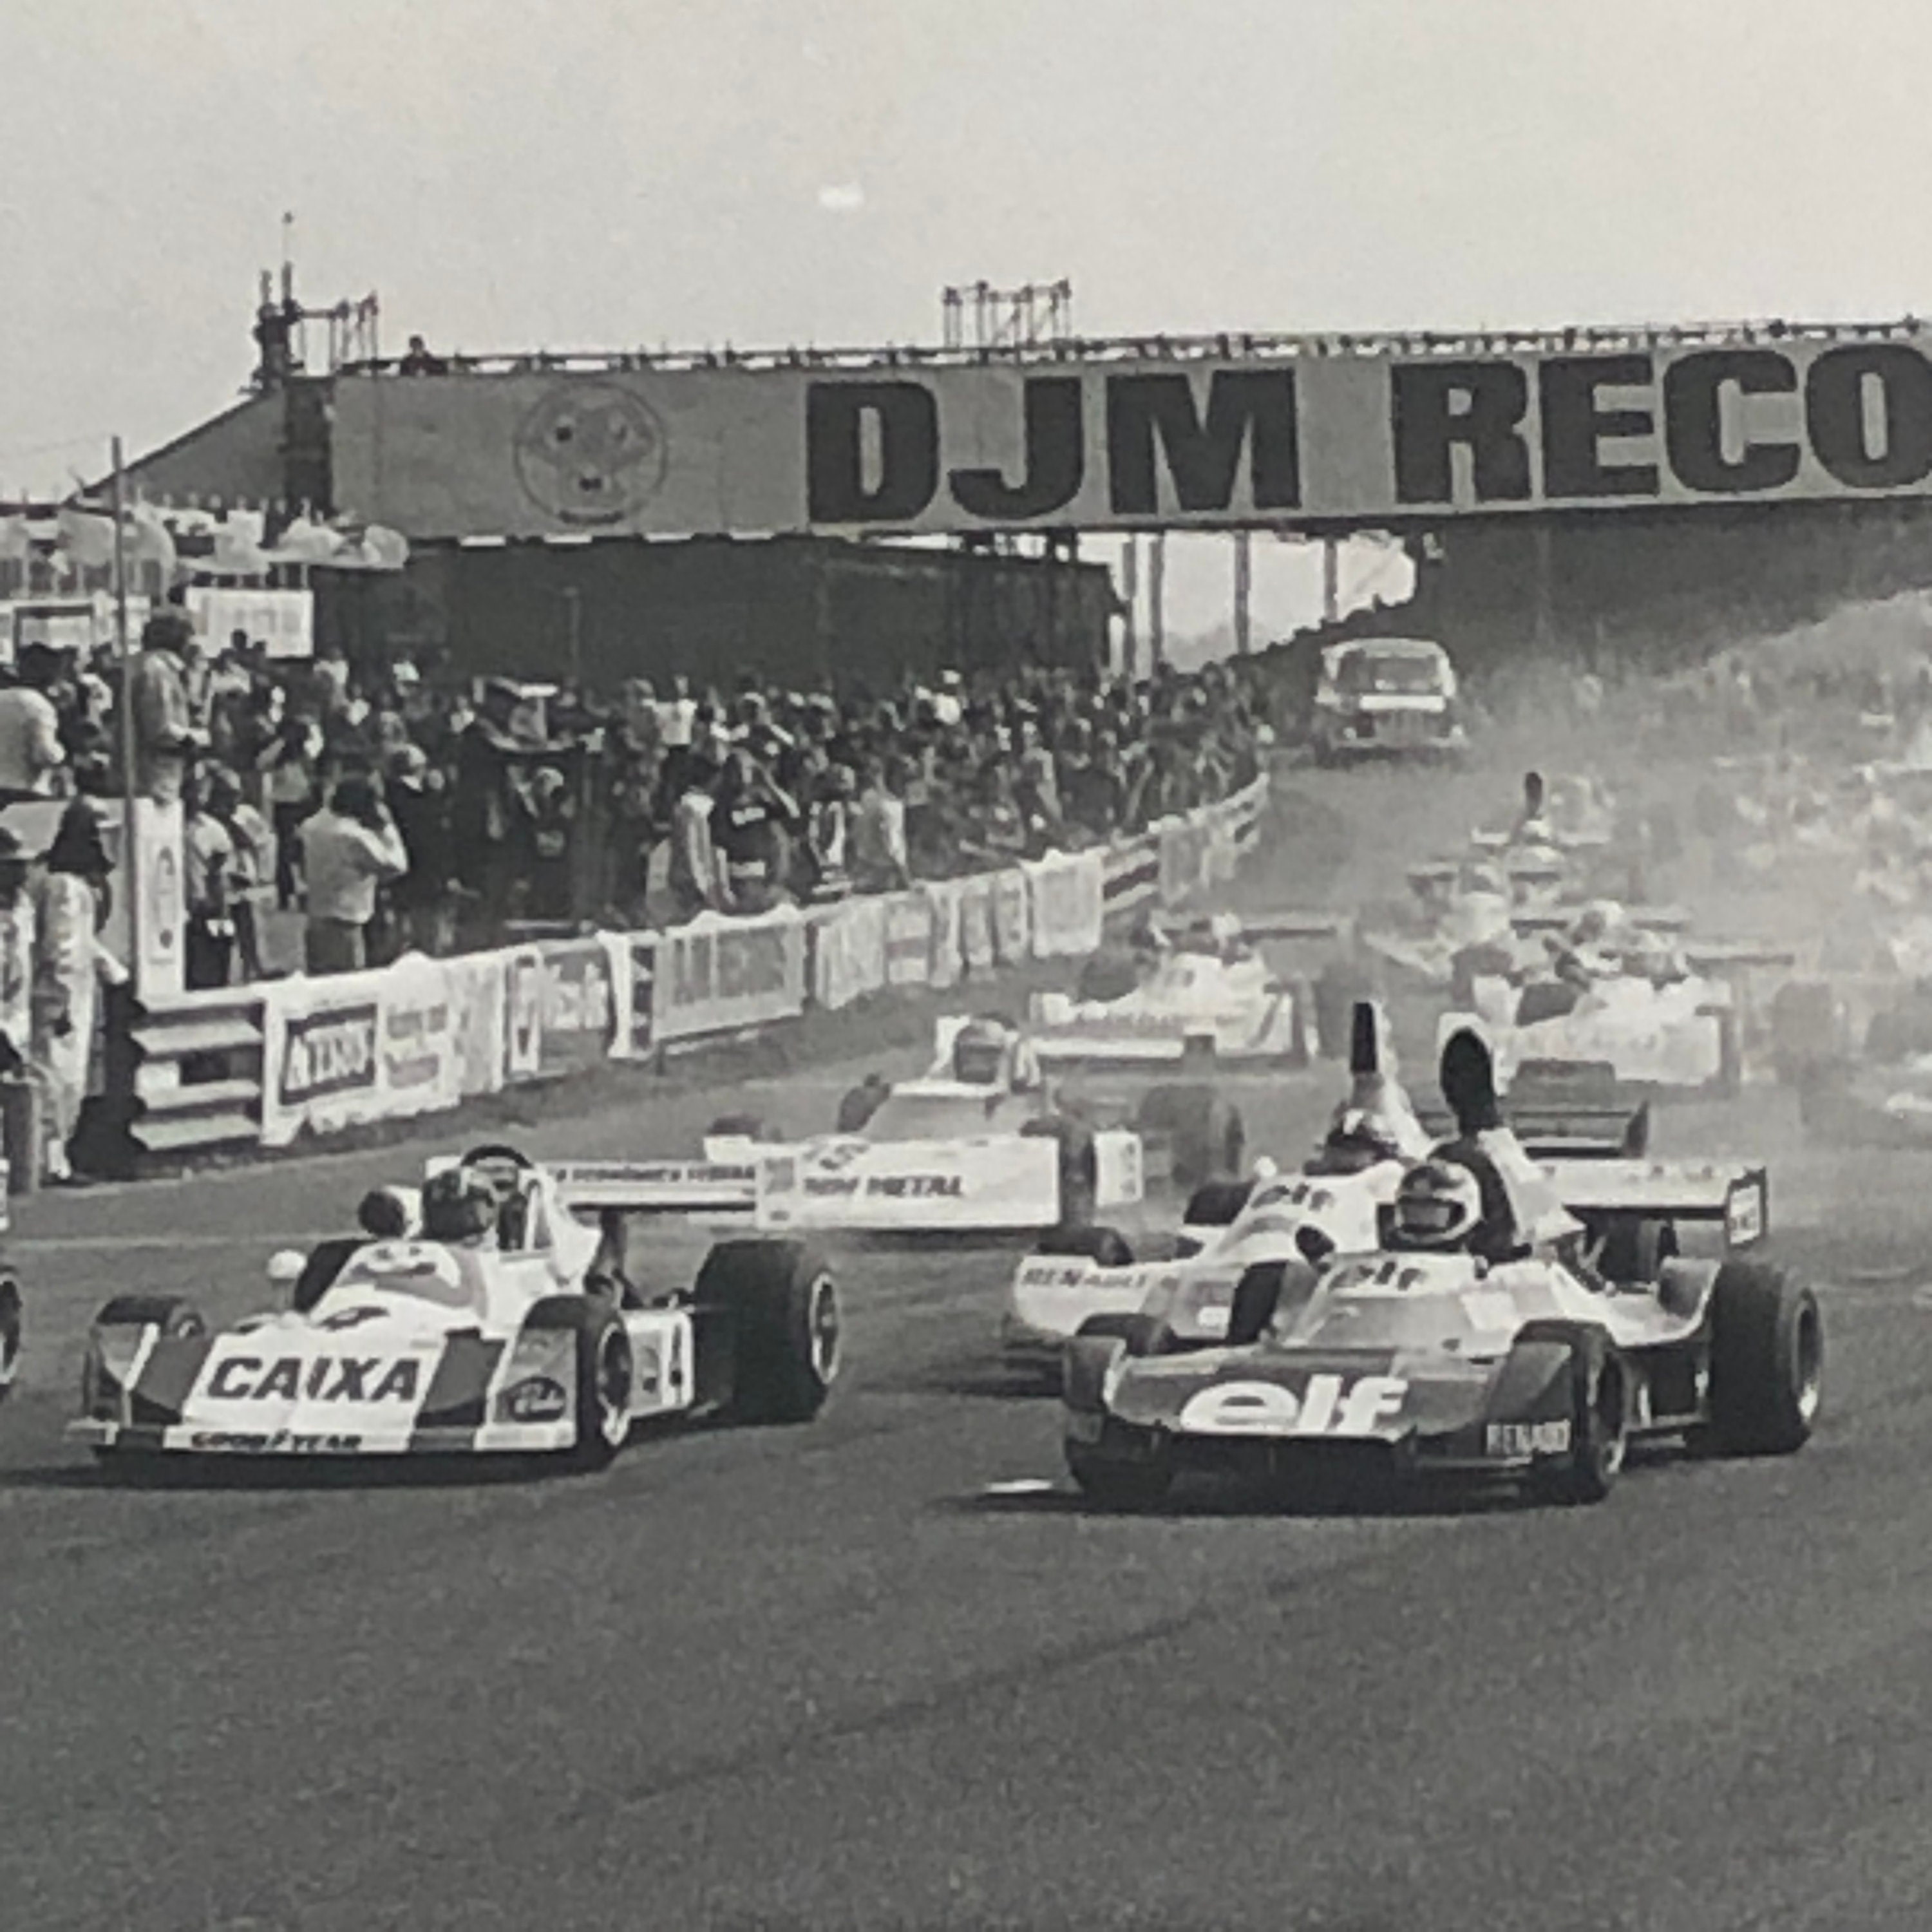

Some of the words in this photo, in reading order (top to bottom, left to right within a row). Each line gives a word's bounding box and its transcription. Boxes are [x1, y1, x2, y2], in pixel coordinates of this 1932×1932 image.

[807, 368, 1302, 522] DJM
[1391, 345, 1932, 504] RECO
[208, 1357, 421, 1402] CAIXA
[1180, 1374, 1409, 1435] elf
